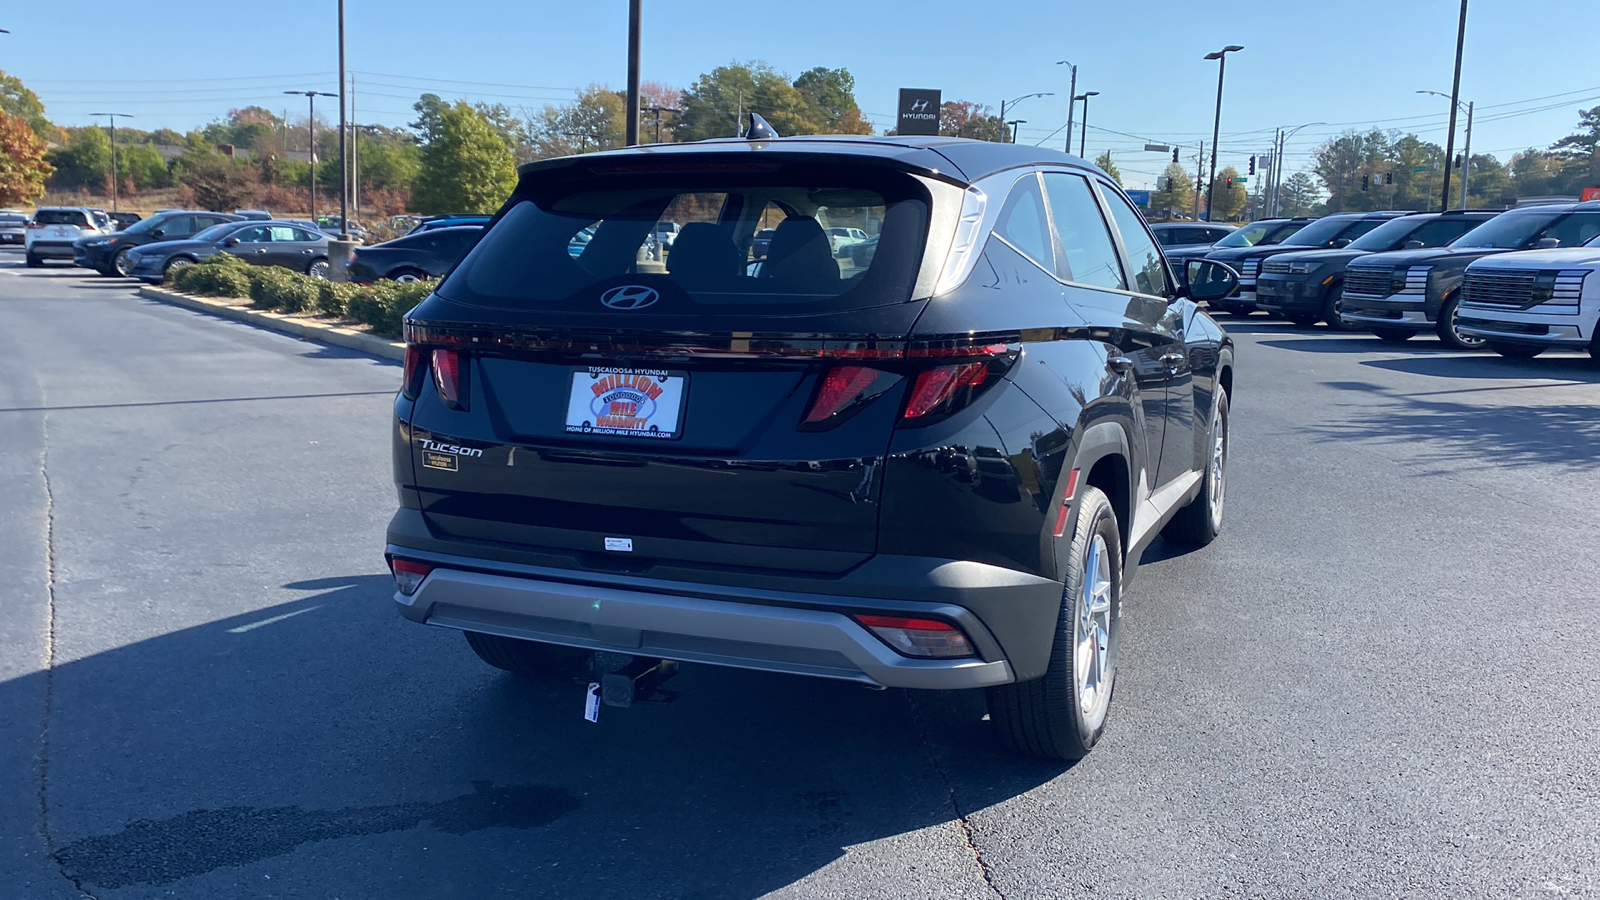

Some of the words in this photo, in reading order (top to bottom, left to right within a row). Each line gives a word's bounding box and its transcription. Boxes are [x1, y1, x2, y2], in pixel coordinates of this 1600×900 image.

[590, 373, 663, 400] MILLION
[609, 401, 637, 417] MILE
[596, 415, 648, 430] WARRANTY
